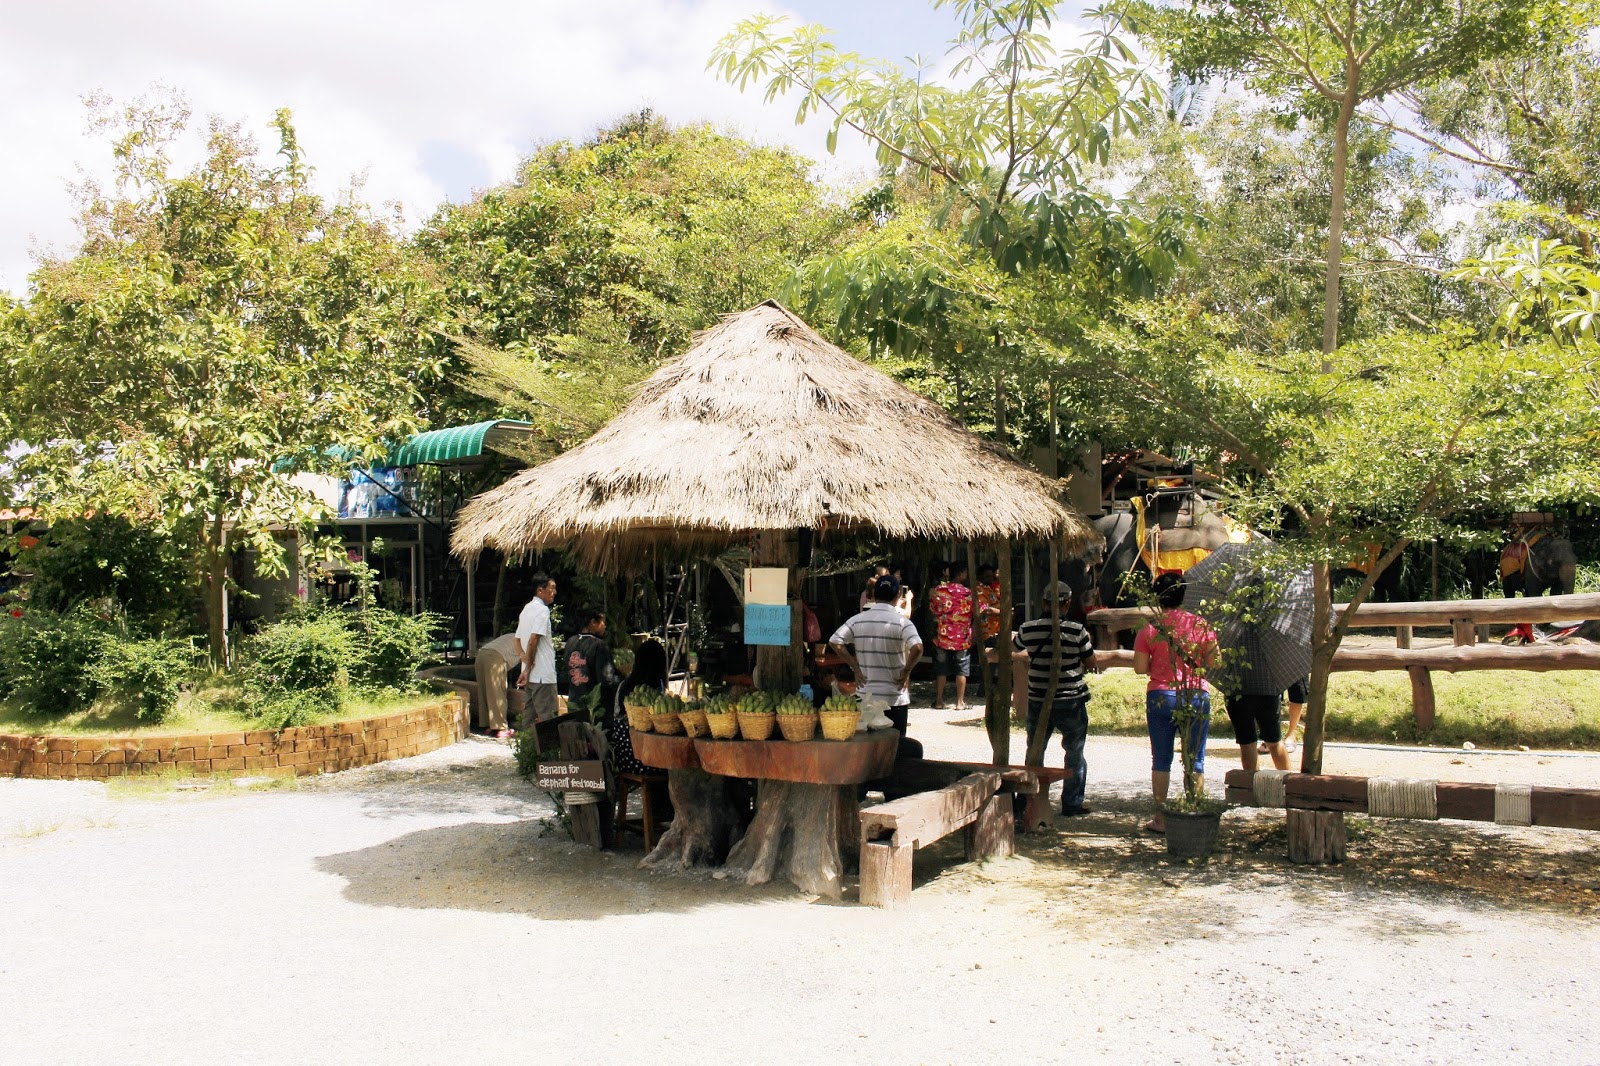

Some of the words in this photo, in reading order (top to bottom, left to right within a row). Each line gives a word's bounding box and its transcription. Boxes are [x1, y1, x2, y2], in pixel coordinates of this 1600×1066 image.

[539, 764, 567, 775] Banana
[568, 764, 579, 774] for
[539, 777, 570, 789] elephant
